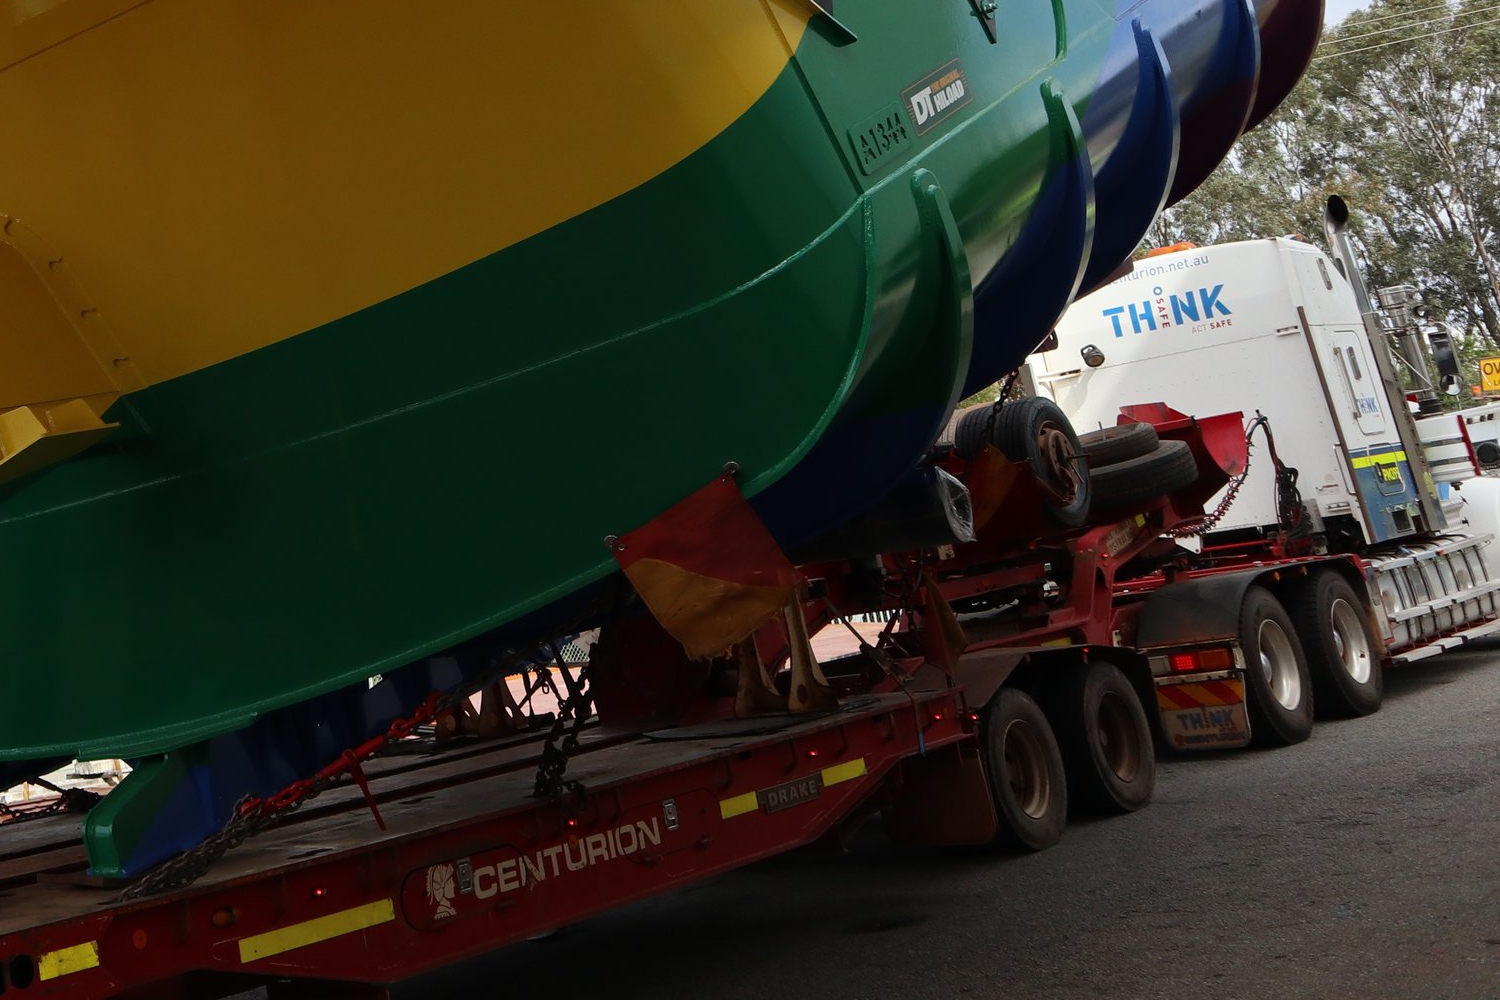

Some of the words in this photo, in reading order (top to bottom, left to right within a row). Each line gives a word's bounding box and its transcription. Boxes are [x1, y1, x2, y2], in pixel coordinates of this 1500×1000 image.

[910, 86, 935, 126] DT
[933, 79, 965, 113] HILOAD
[859, 112, 908, 165] A1344
[1155, 297, 1172, 330] SAFE
[1191, 323, 1208, 335] ACT
[1209, 318, 1233, 330] SAFE
[767, 780, 818, 807] DRAKE
[473, 816, 661, 899] CENTURION
